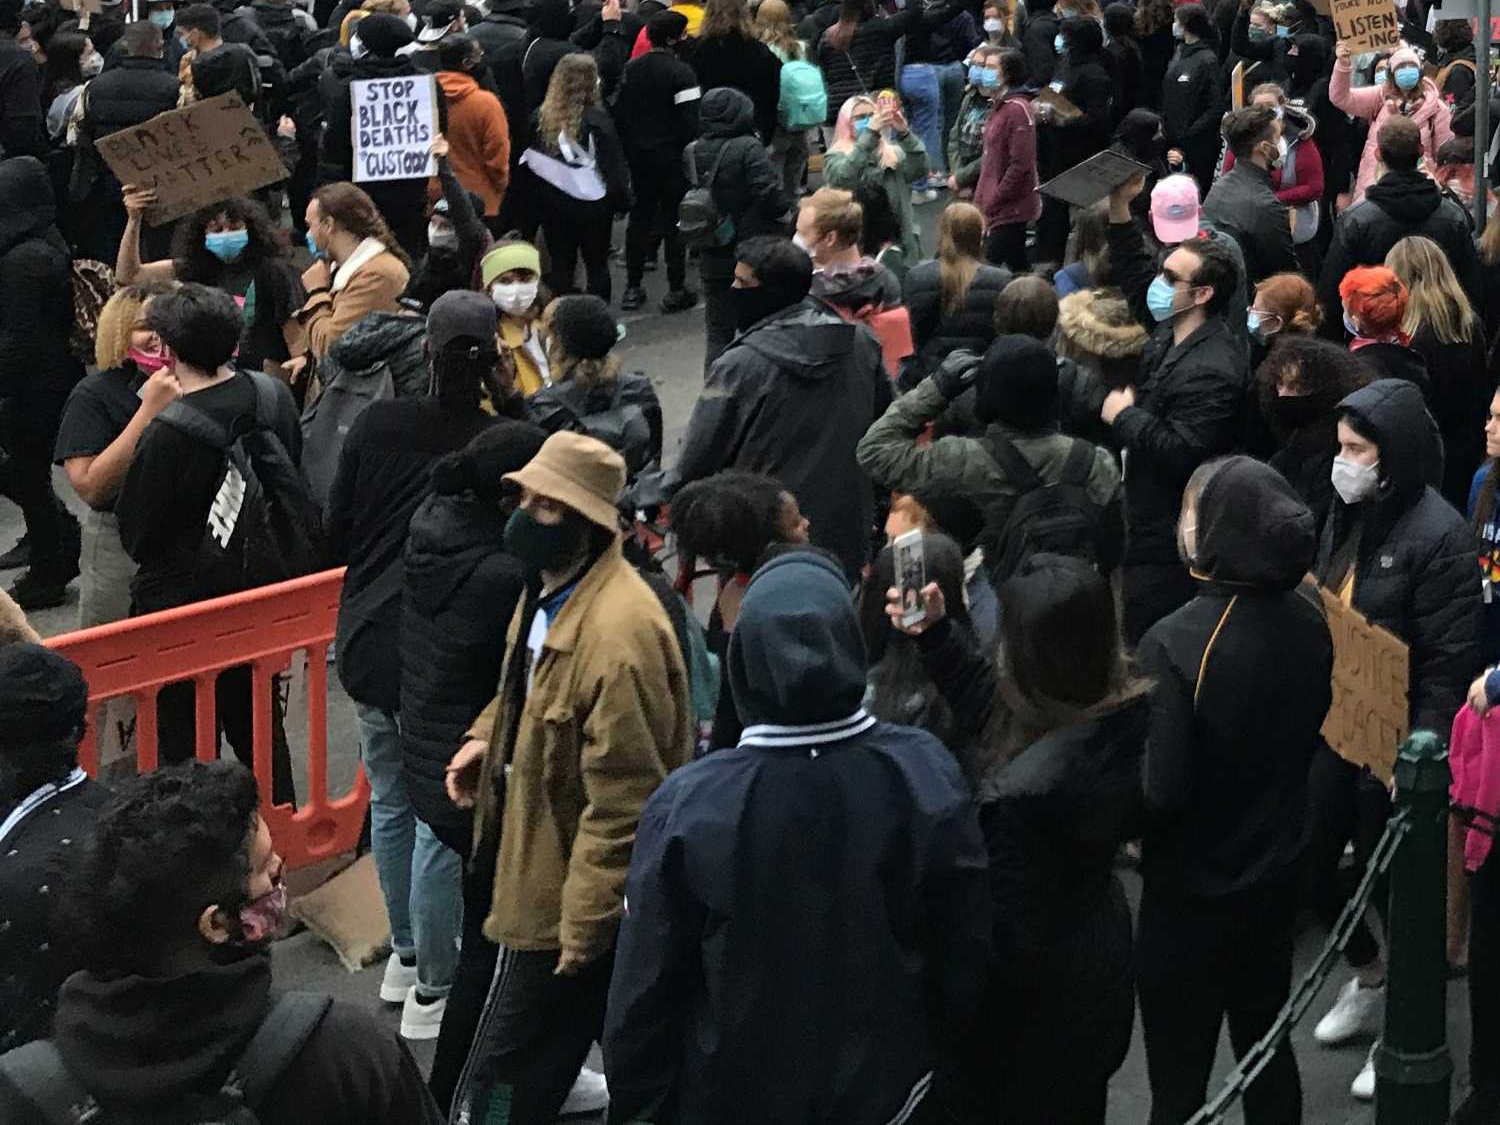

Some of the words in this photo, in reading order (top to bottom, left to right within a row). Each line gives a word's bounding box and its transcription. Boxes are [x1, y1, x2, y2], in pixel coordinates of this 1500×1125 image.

[1336, 12, 1395, 40] LISTEN
[366, 80, 415, 102] STOP
[359, 100, 420, 128] BLACK
[359, 124, 430, 148] DEATHS
[366, 149, 432, 177] CUSTODY
